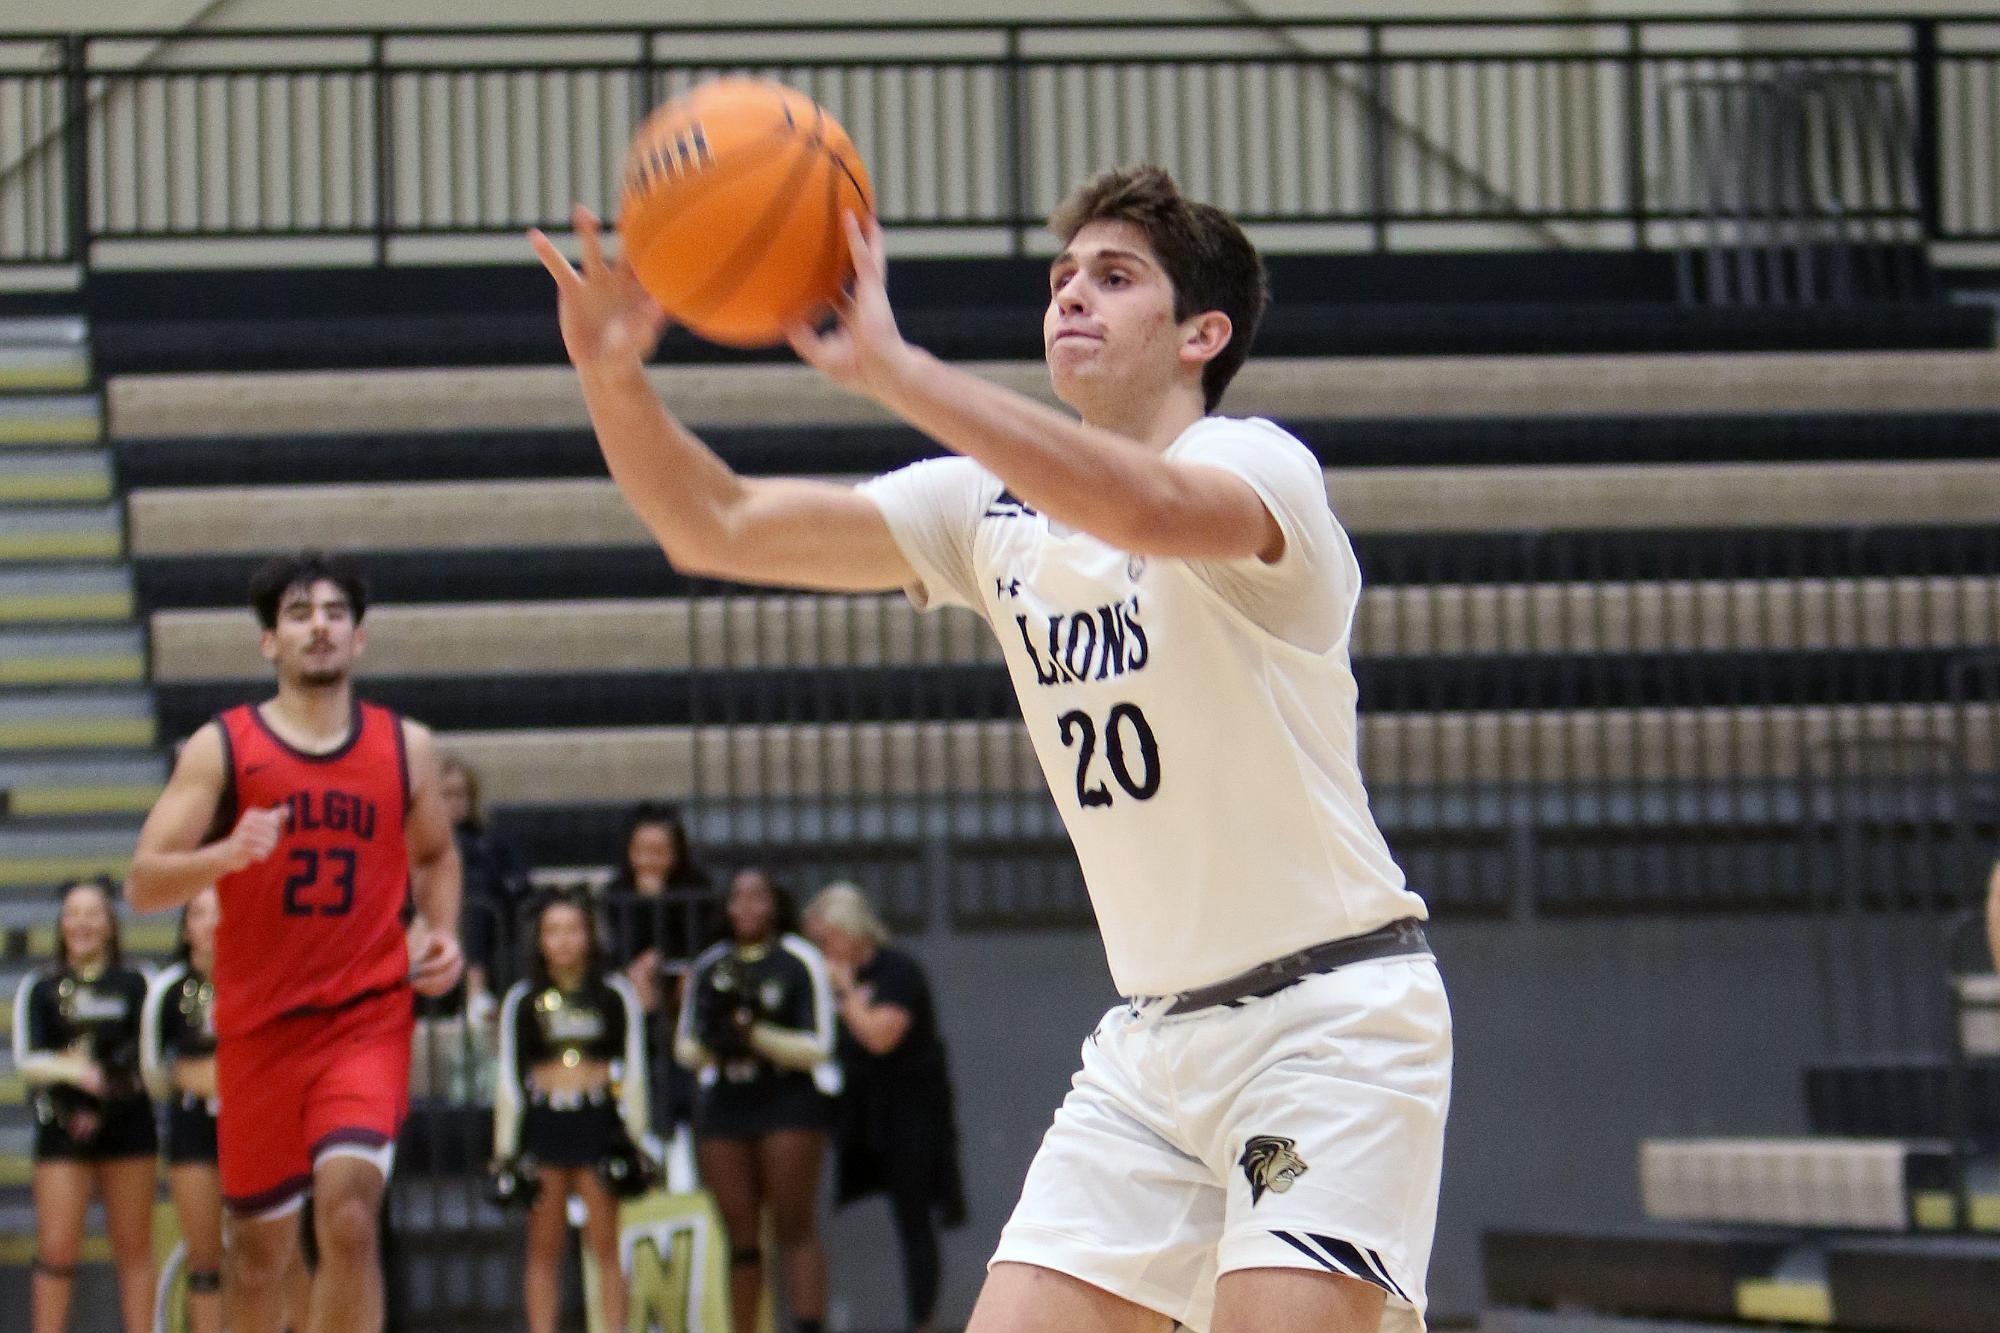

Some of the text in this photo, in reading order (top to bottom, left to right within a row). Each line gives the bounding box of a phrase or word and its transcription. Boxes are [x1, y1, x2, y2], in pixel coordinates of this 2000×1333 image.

[1016, 595, 1149, 685] LIONS
[1057, 702, 1161, 808] 20
[283, 848, 356, 916] 23
